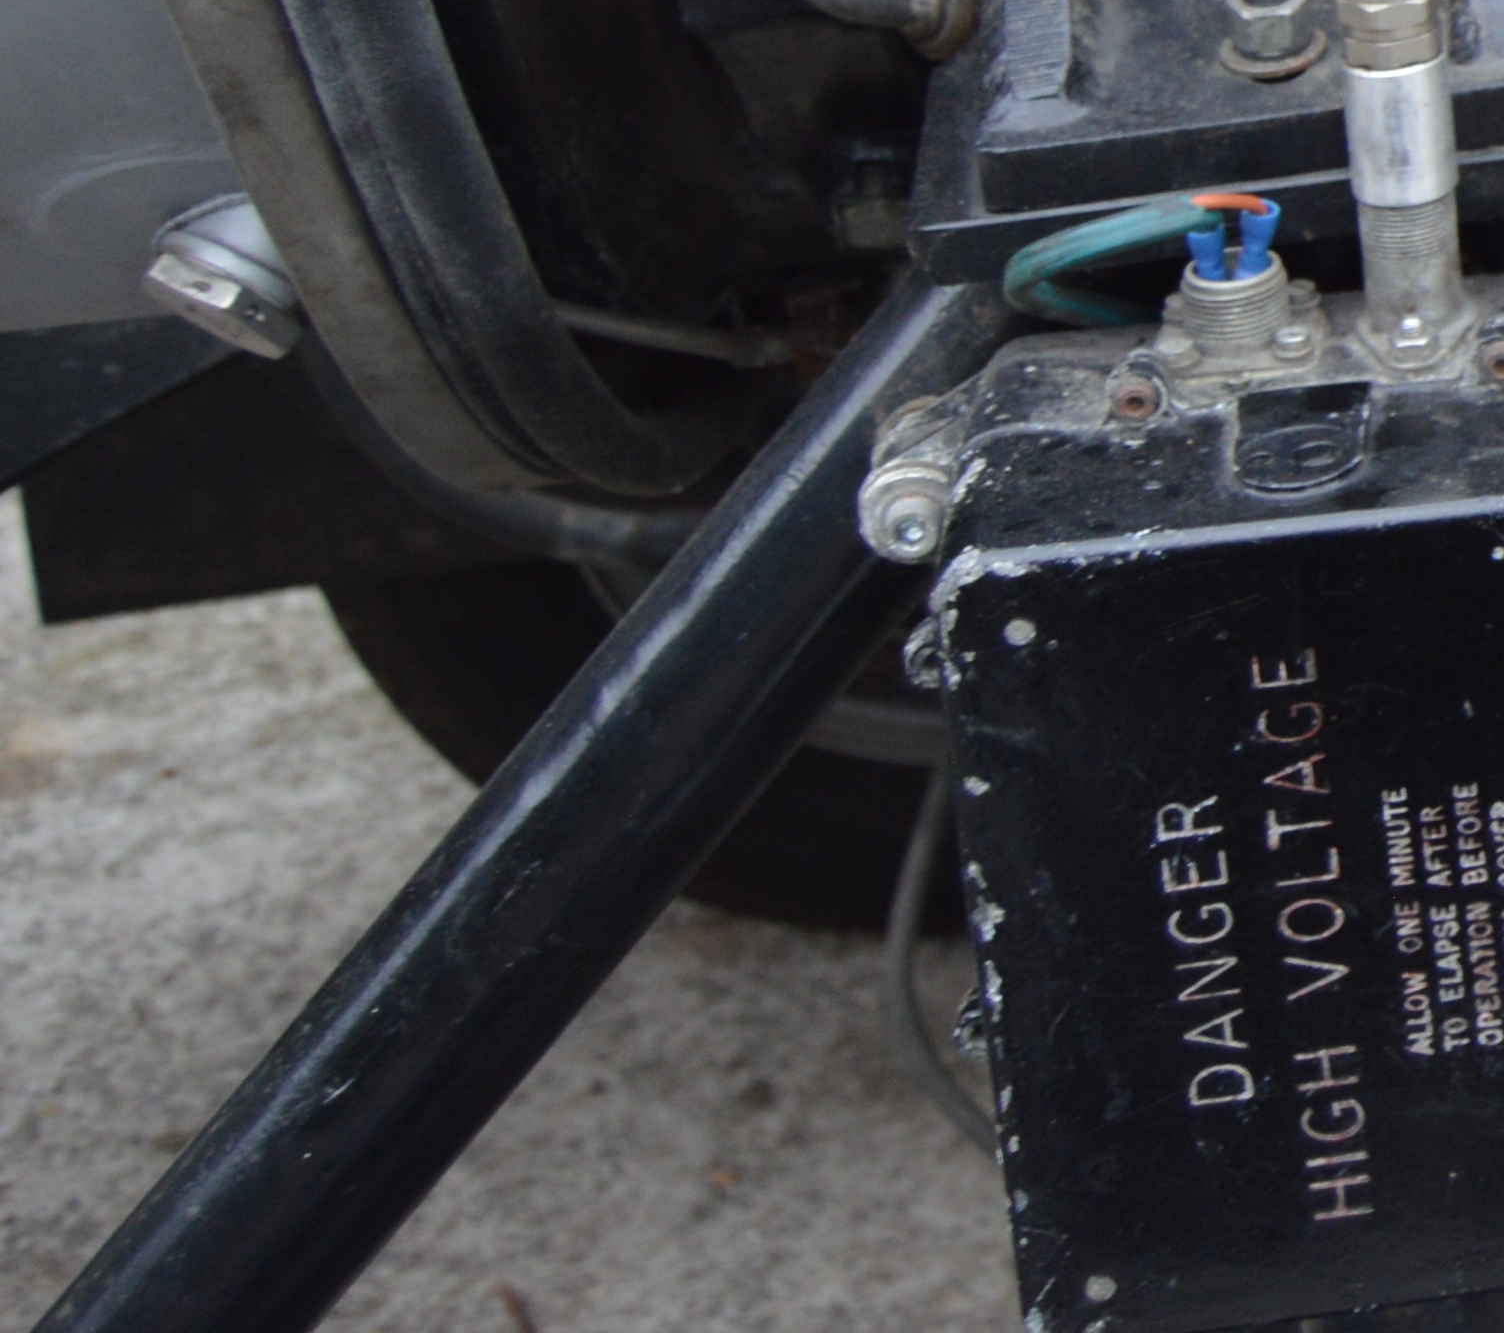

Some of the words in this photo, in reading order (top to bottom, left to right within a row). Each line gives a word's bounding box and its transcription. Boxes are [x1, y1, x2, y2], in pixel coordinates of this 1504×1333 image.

[1249, 646, 1352, 1001] VOLTAGE
[1381, 786, 1415, 887] MINUTE
[1420, 804, 1453, 889] AFTER
[1453, 780, 1489, 886] BEFORE
[1154, 794, 1256, 1107] DANGER
[1393, 899, 1424, 953] ONE
[1430, 902, 1465, 1002] ELAPSE
[1399, 970, 1435, 1057] ALLOW
[1440, 1017, 1471, 1052] TO
[1291, 1043, 1376, 1222] HIGH
